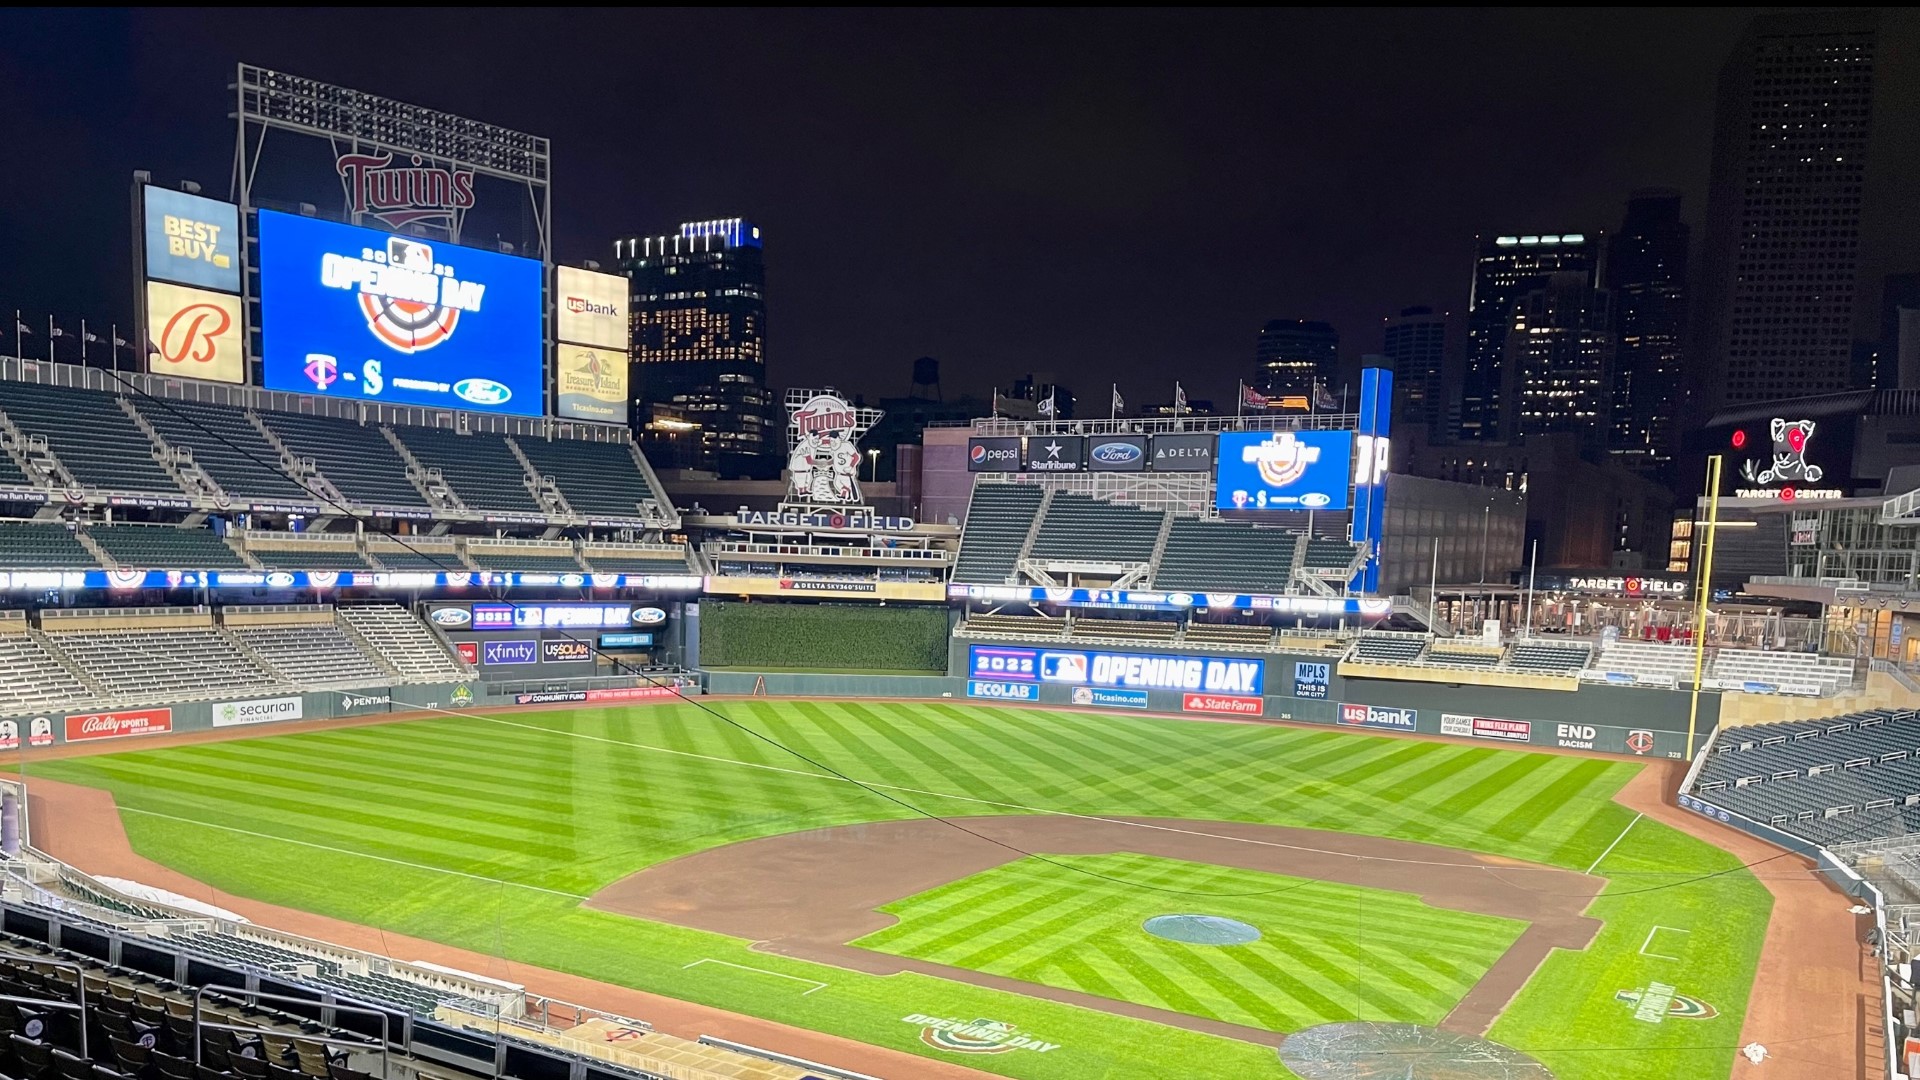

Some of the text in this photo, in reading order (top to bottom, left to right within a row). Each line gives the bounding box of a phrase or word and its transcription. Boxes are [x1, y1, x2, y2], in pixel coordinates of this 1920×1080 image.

[336, 152, 475, 214] Twins
[163, 214, 221, 243] BEST
[169, 236, 216, 262] BUY
[161, 303, 231, 363] B
[565, 372, 620, 390] Treasure Island
[793, 407, 855, 437] Twins
[987, 447, 1018, 461] pepsi
[1101, 446, 1131, 460] Ford
[1168, 448, 1209, 457] DELTA
[1735, 489, 1842, 499] TARGET CENTER
[737, 510, 914, 531] TARGET FIELD
[1570, 578, 1685, 593] TARGET FIELD
[487, 644, 534, 662] xfinity
[977, 655, 1033, 672] 2022
[1091, 655, 1203, 689] OPENING
[1299, 664, 1325, 679] MPLS
[974, 683, 1030, 698] ECOLAB
[1297, 684, 1316, 692] THIS
[353, 695, 391, 707] PENTAIR
[533, 693, 569, 702] COMMUNITY
[570, 692, 586, 700] FUND
[240, 702, 295, 716] securian
[82, 715, 120, 734] Bally
[120, 718, 149, 729] SPORTS
[1557, 724, 1596, 740] END
[1559, 739, 1593, 749] RACISM
[901, 1013, 1061, 1053] OPENING DAY
